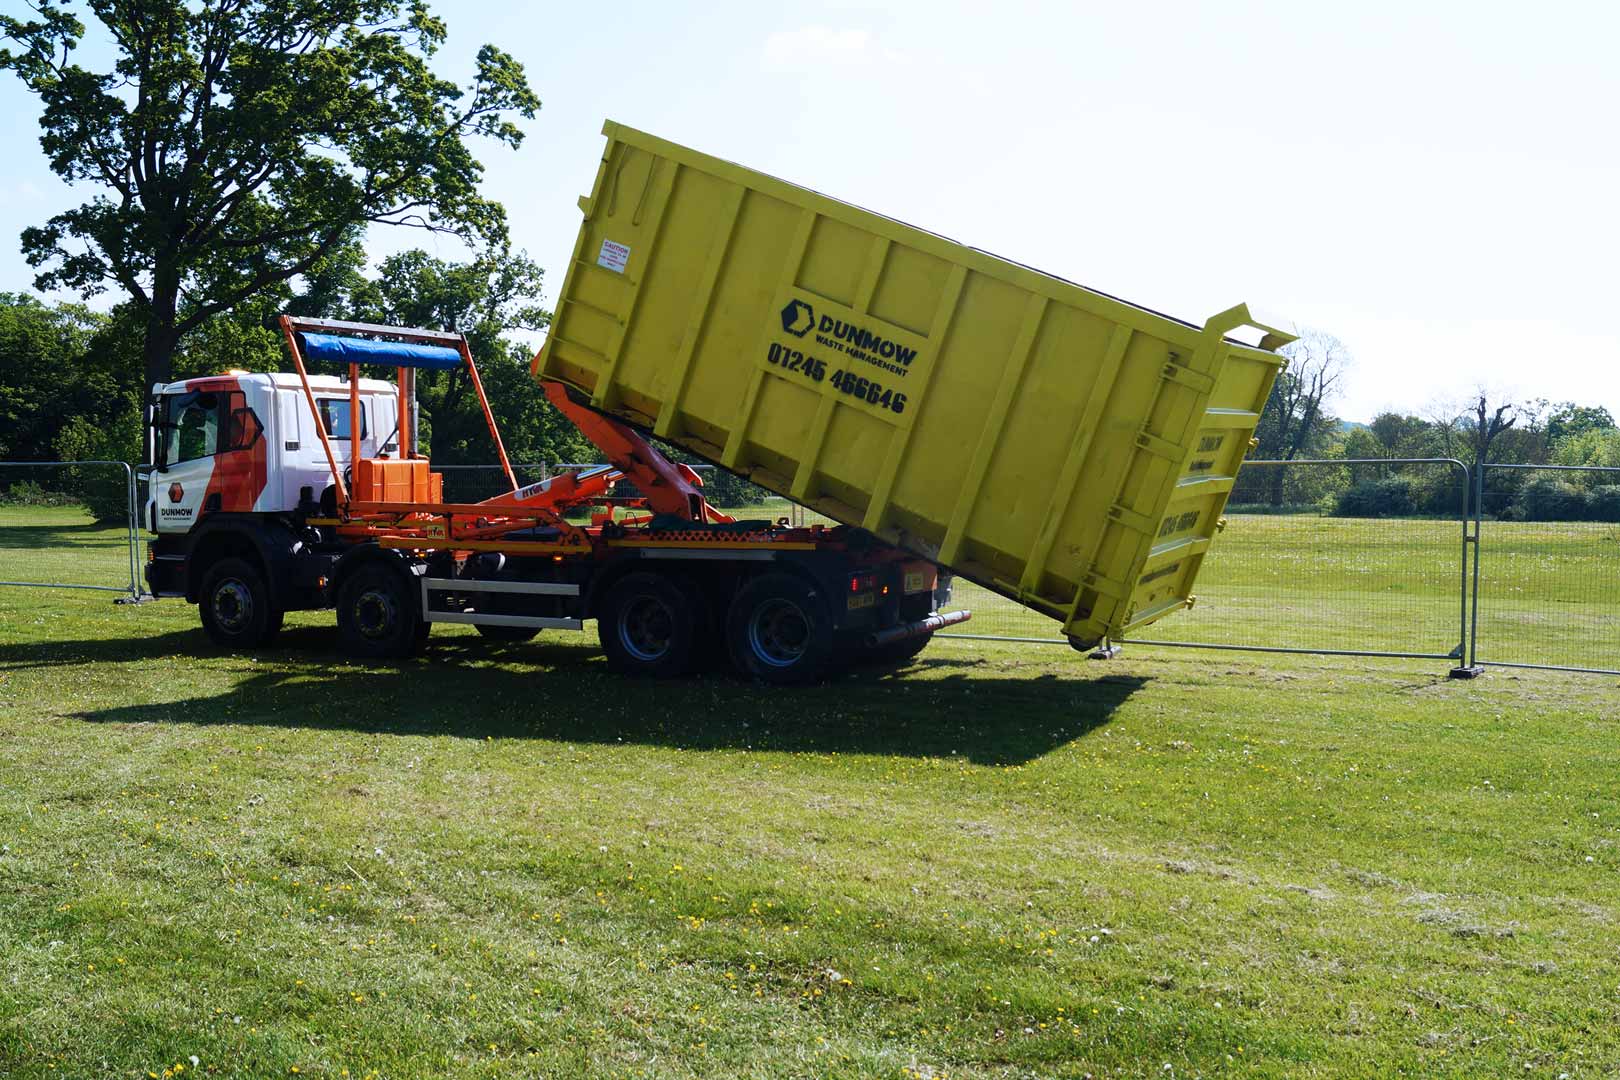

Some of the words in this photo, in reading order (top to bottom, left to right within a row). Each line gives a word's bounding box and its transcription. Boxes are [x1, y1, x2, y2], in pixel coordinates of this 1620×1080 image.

[815, 333, 843, 352] WASTE
[845, 347, 909, 377] MANAGEMENT
[818, 314, 918, 367] DUNMOW
[767, 342, 828, 382] 01245
[829, 368, 908, 414] 466646
[161, 507, 193, 516] DUNMOW
